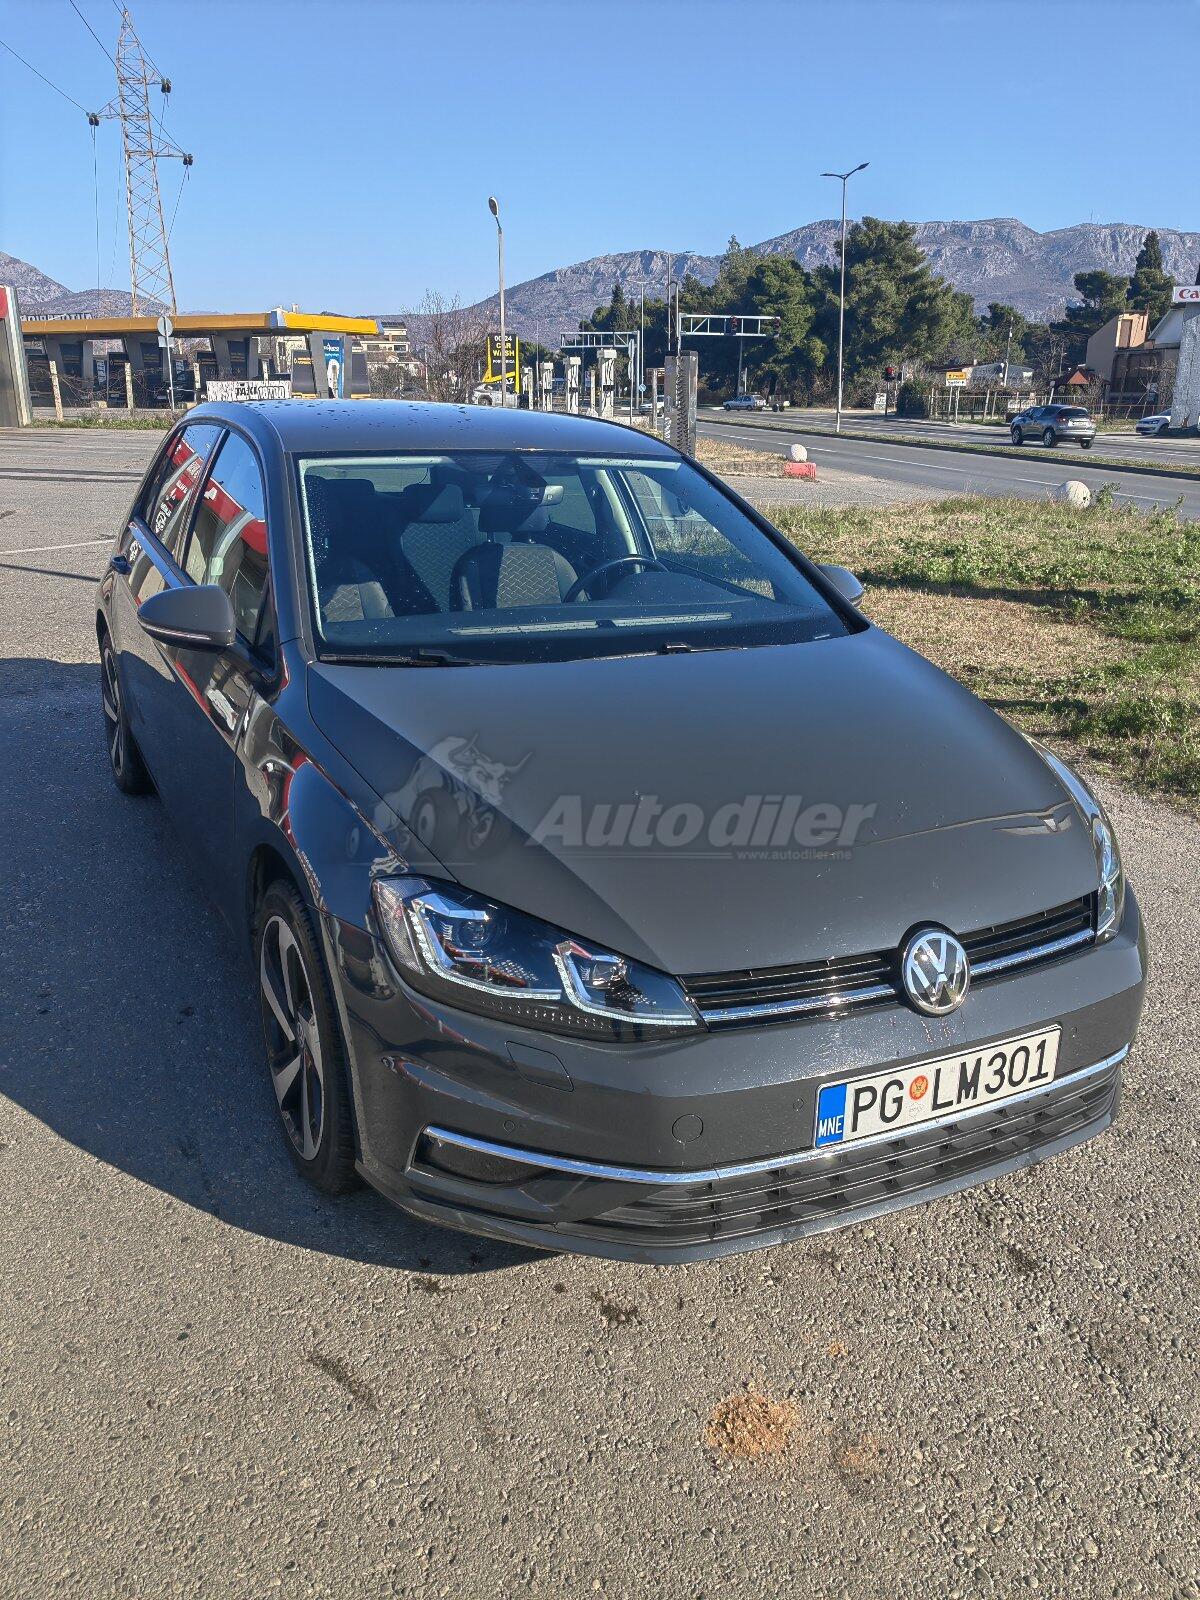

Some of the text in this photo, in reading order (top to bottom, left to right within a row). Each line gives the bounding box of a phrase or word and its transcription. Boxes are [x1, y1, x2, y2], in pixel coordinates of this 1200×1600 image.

[1178, 288, 1200, 300] Ca
[851, 1039, 1050, 1132] PG LM301
[818, 1114, 844, 1138] MNE
